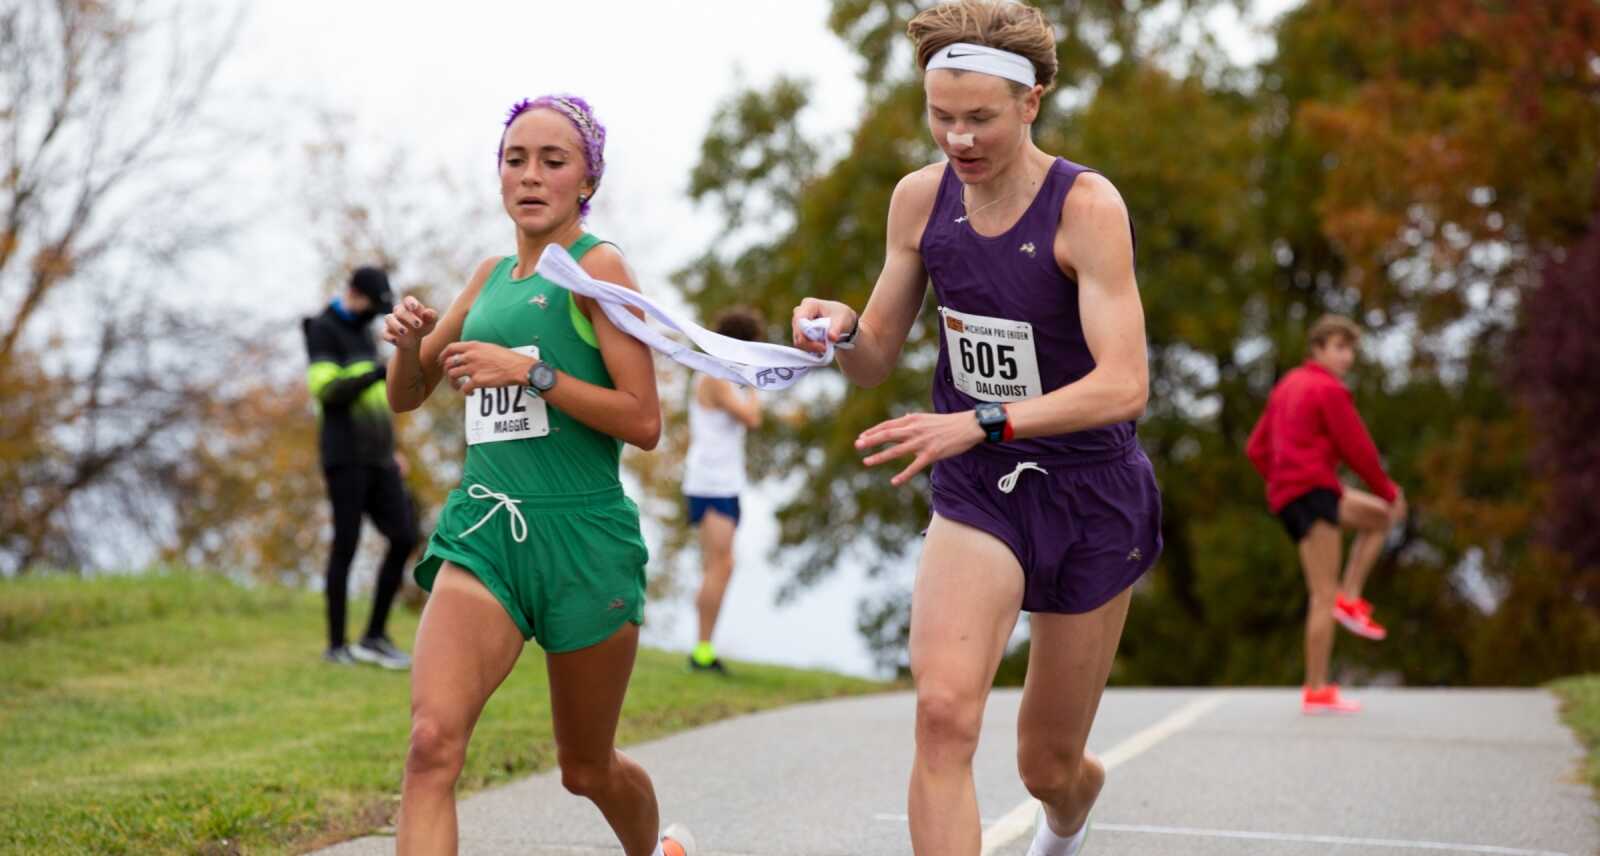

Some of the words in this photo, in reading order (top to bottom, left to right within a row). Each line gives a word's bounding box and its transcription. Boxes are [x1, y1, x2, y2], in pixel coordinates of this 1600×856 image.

[964, 324, 992, 337] MICHIGAN
[994, 328, 1005, 338] PRO
[960, 337, 1018, 380] 605
[976, 381, 1027, 397] DALQUIST
[480, 386, 527, 417] 602
[494, 418, 530, 433] MAGGIE
